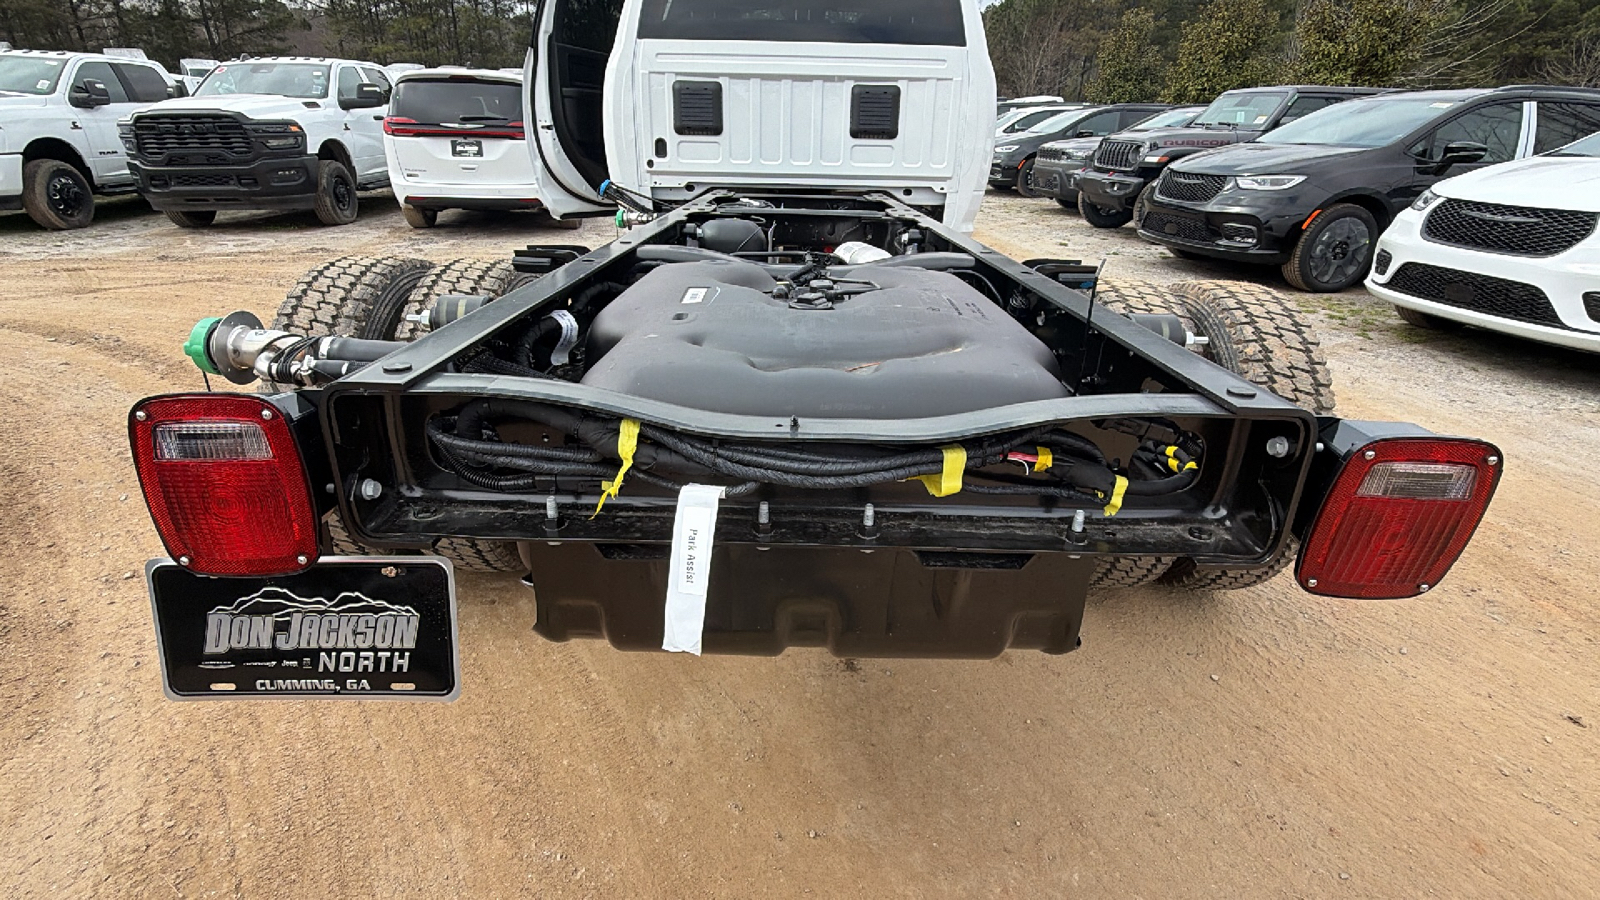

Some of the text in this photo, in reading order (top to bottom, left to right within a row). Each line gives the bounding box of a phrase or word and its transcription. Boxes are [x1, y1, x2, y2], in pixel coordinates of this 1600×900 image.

[686, 528, 698, 584] Park Assist
[203, 611, 420, 654] DON JACKSON
[318, 651, 410, 673] NORTH
[255, 679, 371, 692] CUMMING, GA
